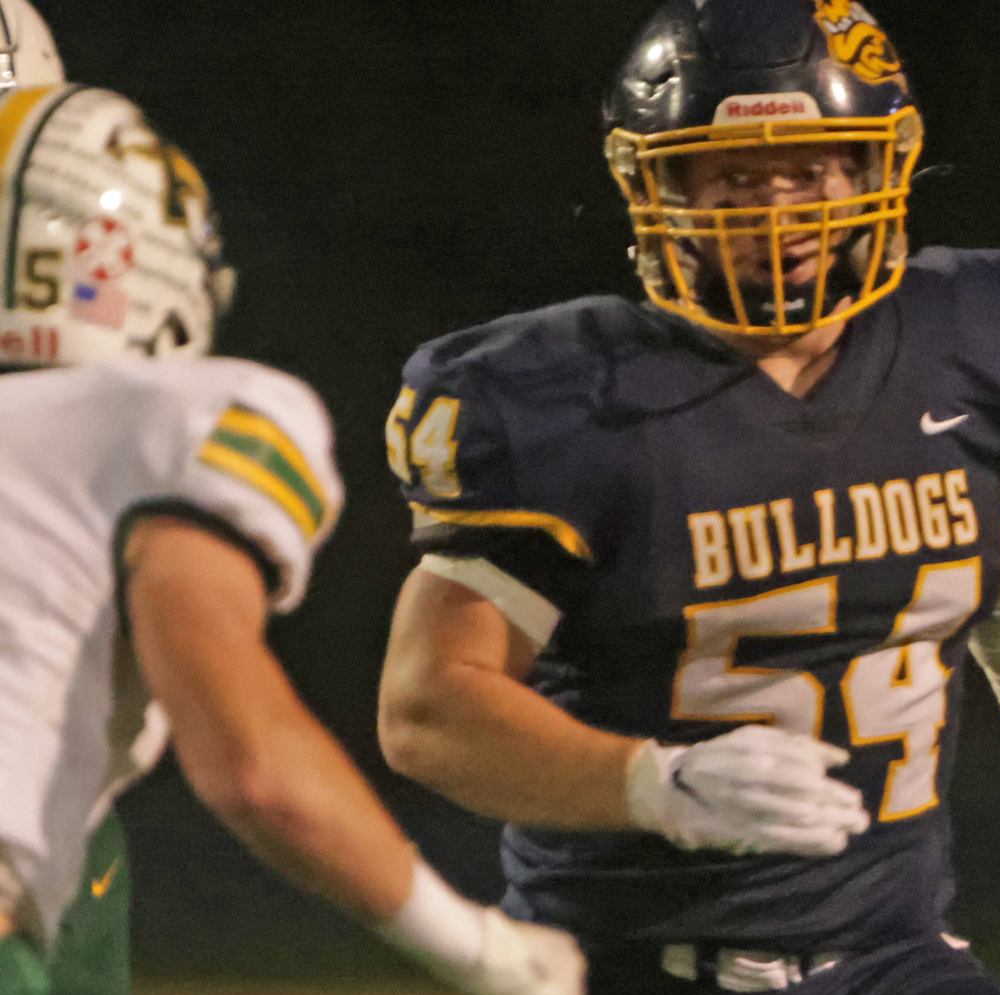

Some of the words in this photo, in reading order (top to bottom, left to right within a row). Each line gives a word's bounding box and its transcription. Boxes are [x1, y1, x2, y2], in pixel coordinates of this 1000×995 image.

[726, 100, 805, 118] Riddell
[19, 248, 63, 312] 5
[687, 469, 979, 589] BULLDOGS
[670, 555, 982, 822] 54
